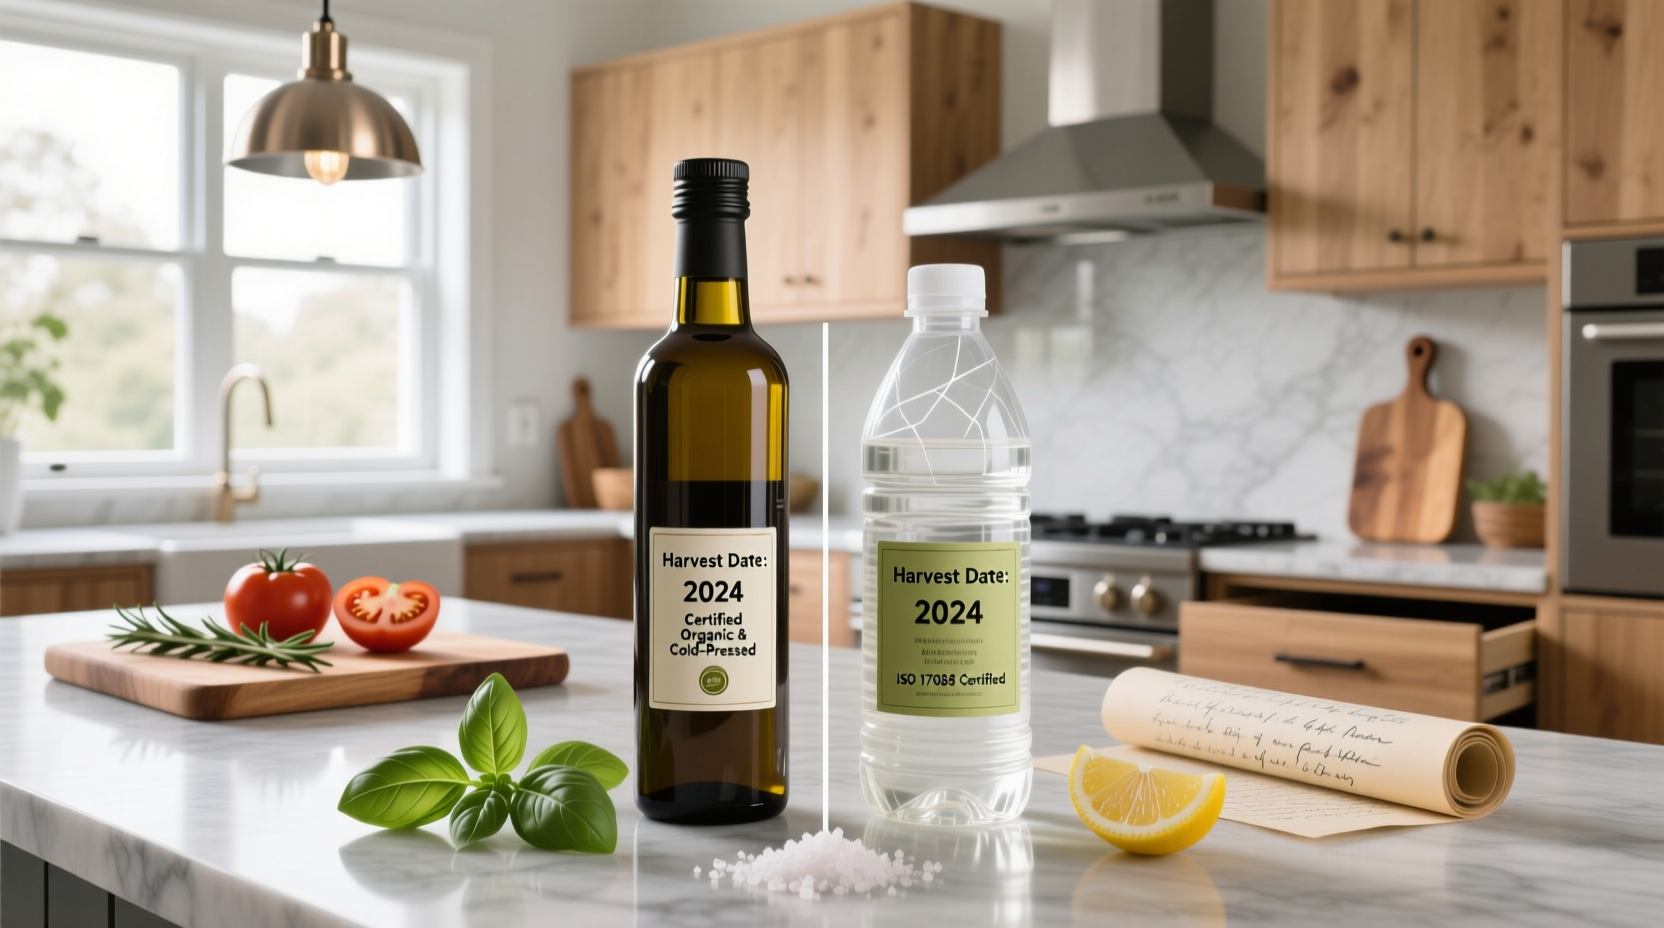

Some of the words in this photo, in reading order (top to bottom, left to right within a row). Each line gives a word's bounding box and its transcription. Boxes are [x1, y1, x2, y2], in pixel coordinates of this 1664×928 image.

[663, 552, 723, 568] Harvest
[728, 553, 767, 568] Date:
[893, 566, 960, 584] Harvest
[965, 567, 1009, 584] Date:
[683, 580, 744, 603] 2024
[684, 612, 743, 626] Certified
[914, 599, 984, 625] 2024
[680, 628, 735, 644] Organic
[737, 628, 747, 641] &
[669, 642, 756, 657] Cold-Pressed
[896, 672, 916, 686] ISO
